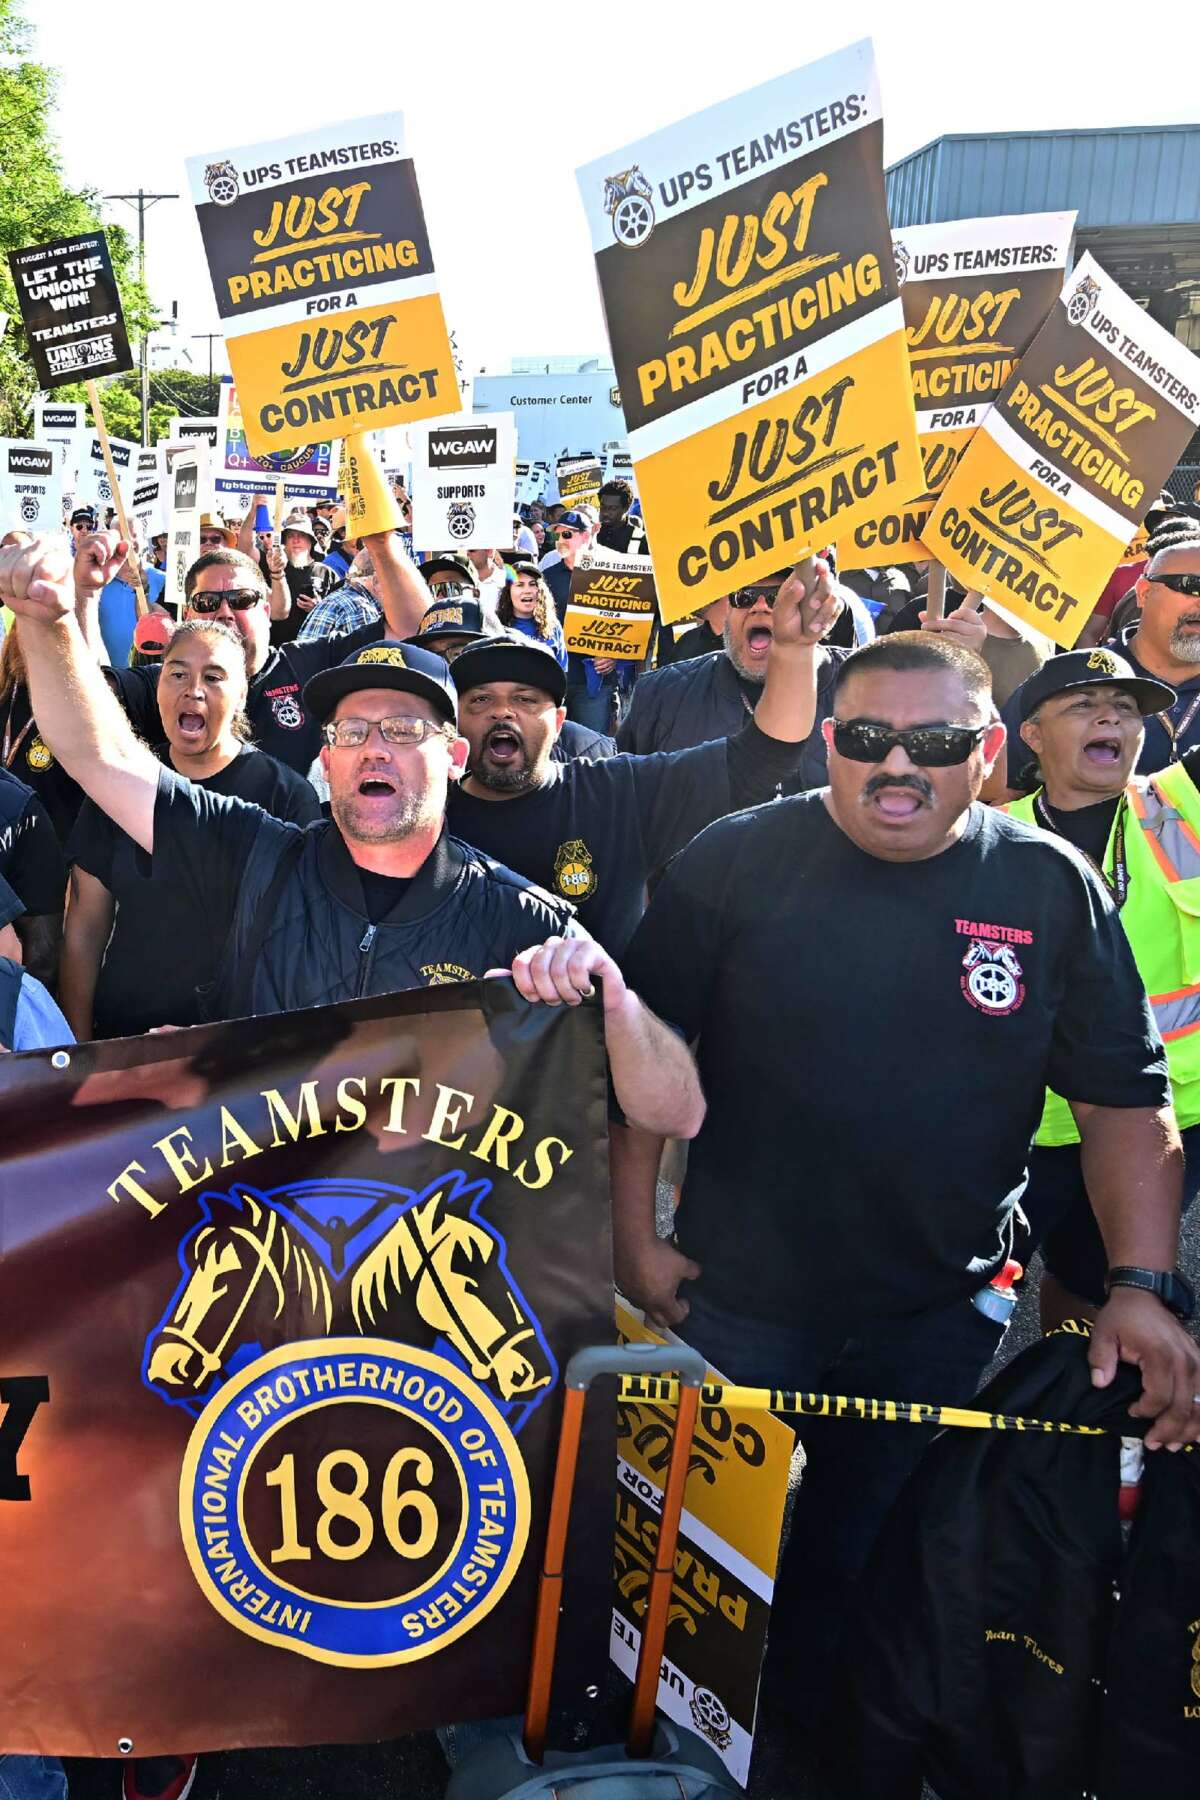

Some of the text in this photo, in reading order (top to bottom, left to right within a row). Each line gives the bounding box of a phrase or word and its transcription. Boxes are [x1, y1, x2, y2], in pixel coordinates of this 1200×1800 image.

[243, 140, 399, 187] UPS TEAMSTERS:
[659, 94, 867, 208] UPS TEAMSTERS:
[253, 181, 371, 247] JUST
[673, 172, 829, 308] JUST
[22, 256, 103, 287] LET THE
[228, 239, 418, 303] PRACTICING
[914, 245, 1058, 274] UPS TEAMSTERS:
[28, 273, 96, 300] UNIONS
[49, 291, 90, 311] WIN!
[306, 293, 357, 315] FOR A
[32, 313, 117, 341] TEAMSTERS
[637, 253, 882, 407] PRACTICING
[906, 288, 1020, 346] JUST
[50, 351, 115, 372] STRIKE BACK
[281, 315, 397, 378] JUST
[1090, 311, 1200, 415] UPS TEAMSTERS:
[743, 356, 808, 404] FOR A
[914, 359, 1020, 398] ACTICIN
[1054, 357, 1156, 435] JUST
[43, 414, 75, 424] WGAW
[260, 369, 439, 433] CONTRACT
[511, 395, 592, 406] Customer Center
[930, 408, 976, 429] FOR A
[92, 442, 129, 460] WAW
[431, 439, 494, 456] WGAW
[708, 375, 854, 501] JUST
[1007, 380, 1144, 509] PRACTICING
[10, 456, 50, 468] WGAW
[350, 456, 360, 494] GAME
[567, 472, 592, 484] JUST
[1029, 459, 1072, 497] FOR A
[14, 484, 46, 496] SUPPORTS
[175, 478, 197, 495] WGAW
[222, 481, 328, 496] lgbtqteamters.org
[437, 484, 485, 499] SUPPORTS
[678, 440, 900, 587] CONTRACT
[979, 479, 1083, 553] JUST
[589, 575, 643, 592] JUST
[613, 563, 652, 571] TEAMSTER
[939, 507, 1079, 623] CONTRACT
[574, 594, 651, 610] PRACTICING
[568, 637, 641, 654] CONTRACT
[582, 620, 633, 636] JUST
[563, 872, 588, 885] 186
[954, 918, 1033, 945] TEAMSTERS
[108, 1076, 574, 1221] TEAMSTERS
[239, 1361, 466, 1434] BROTHERHOOD
[461, 1428, 498, 1470] OF
[266, 1446, 439, 1564] 186
[202, 1429, 312, 1634] INTERNATIONAL
[401, 1476, 507, 1638] TEAMSTERS
[1024, 1636, 1064, 1674] Flores
